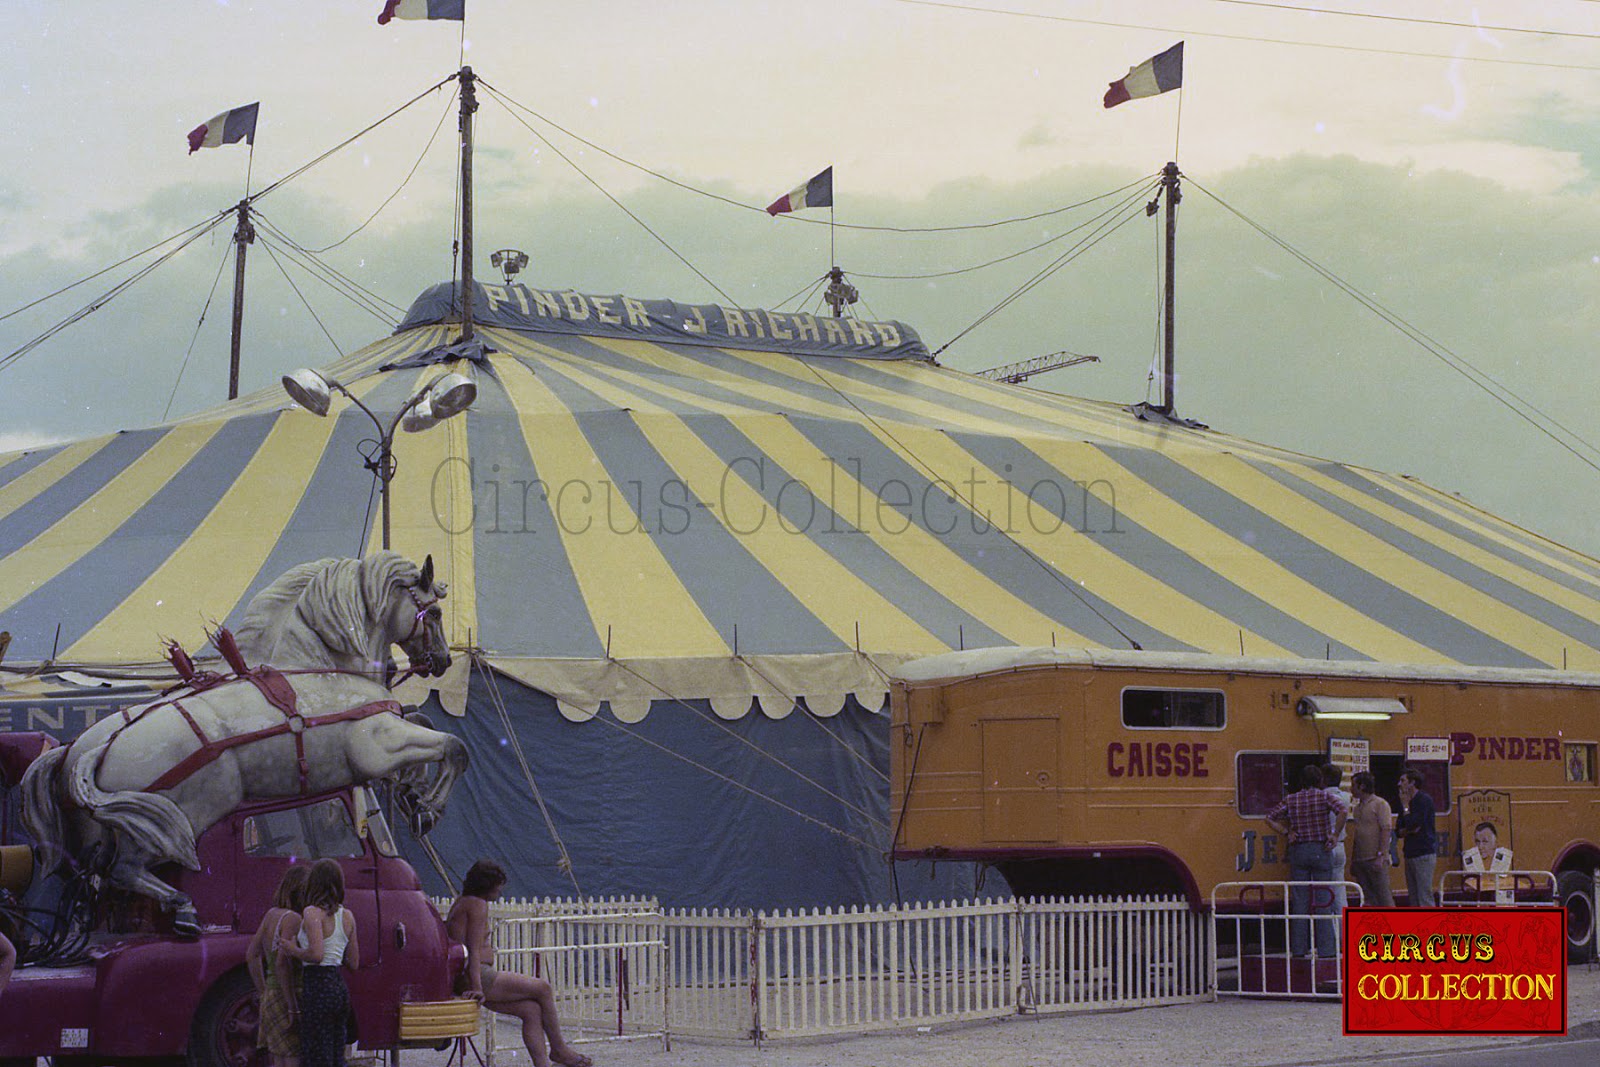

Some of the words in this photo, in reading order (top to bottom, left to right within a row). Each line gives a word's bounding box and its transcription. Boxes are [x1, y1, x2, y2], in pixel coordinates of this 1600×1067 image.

[483, 283, 652, 328] PINDER
[683, 317, 707, 336] J
[725, 307, 902, 347] RICHARD
[1107, 742, 1209, 777] CAISSE
[1450, 732, 1562, 765] PINDER
